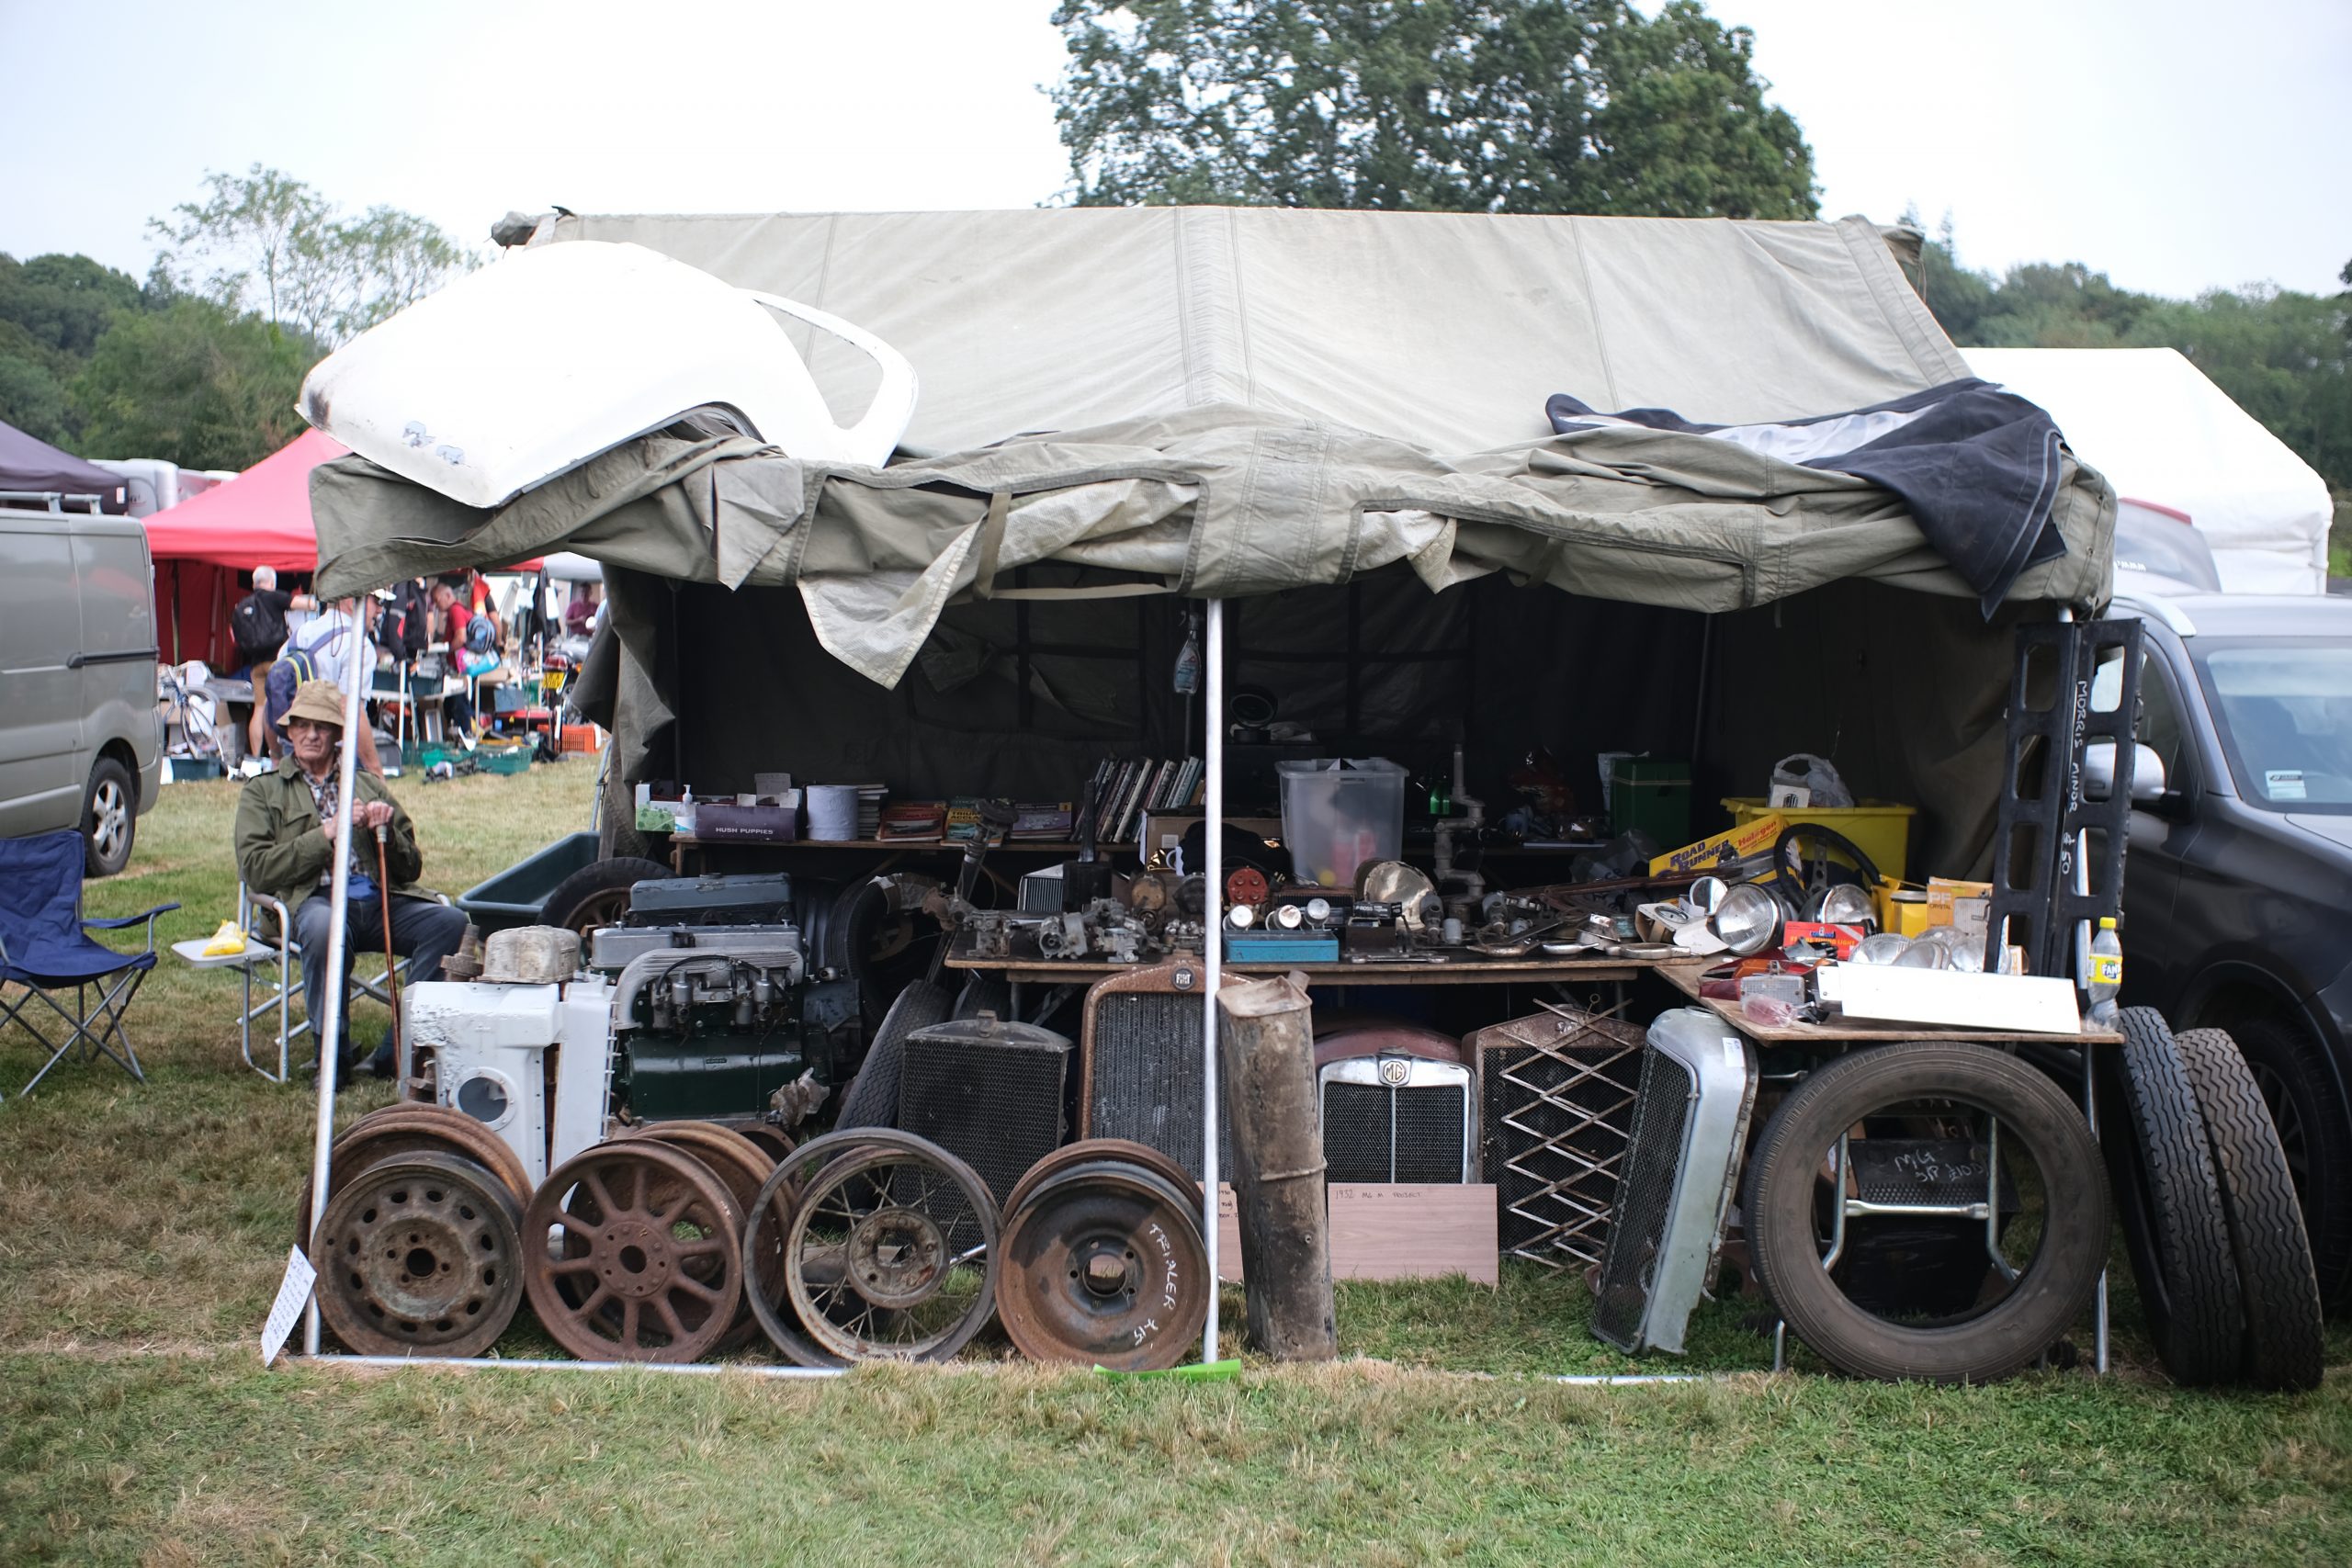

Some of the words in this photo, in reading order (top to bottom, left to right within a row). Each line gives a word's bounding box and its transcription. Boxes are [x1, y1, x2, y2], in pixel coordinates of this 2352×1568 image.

[2074, 680, 2088, 750] MORRIS
[2068, 761, 2080, 814] MINOR
[740, 828, 774, 836] PUPPIES
[1737, 820, 1777, 847] Halogen
[1669, 841, 1706, 867] ROAD
[1679, 840, 1730, 873] RUNNER
[1176, 973, 1192, 985] FIAT
[1385, 1063, 1403, 1081] MG
[1335, 1189, 1354, 1200] 1932
